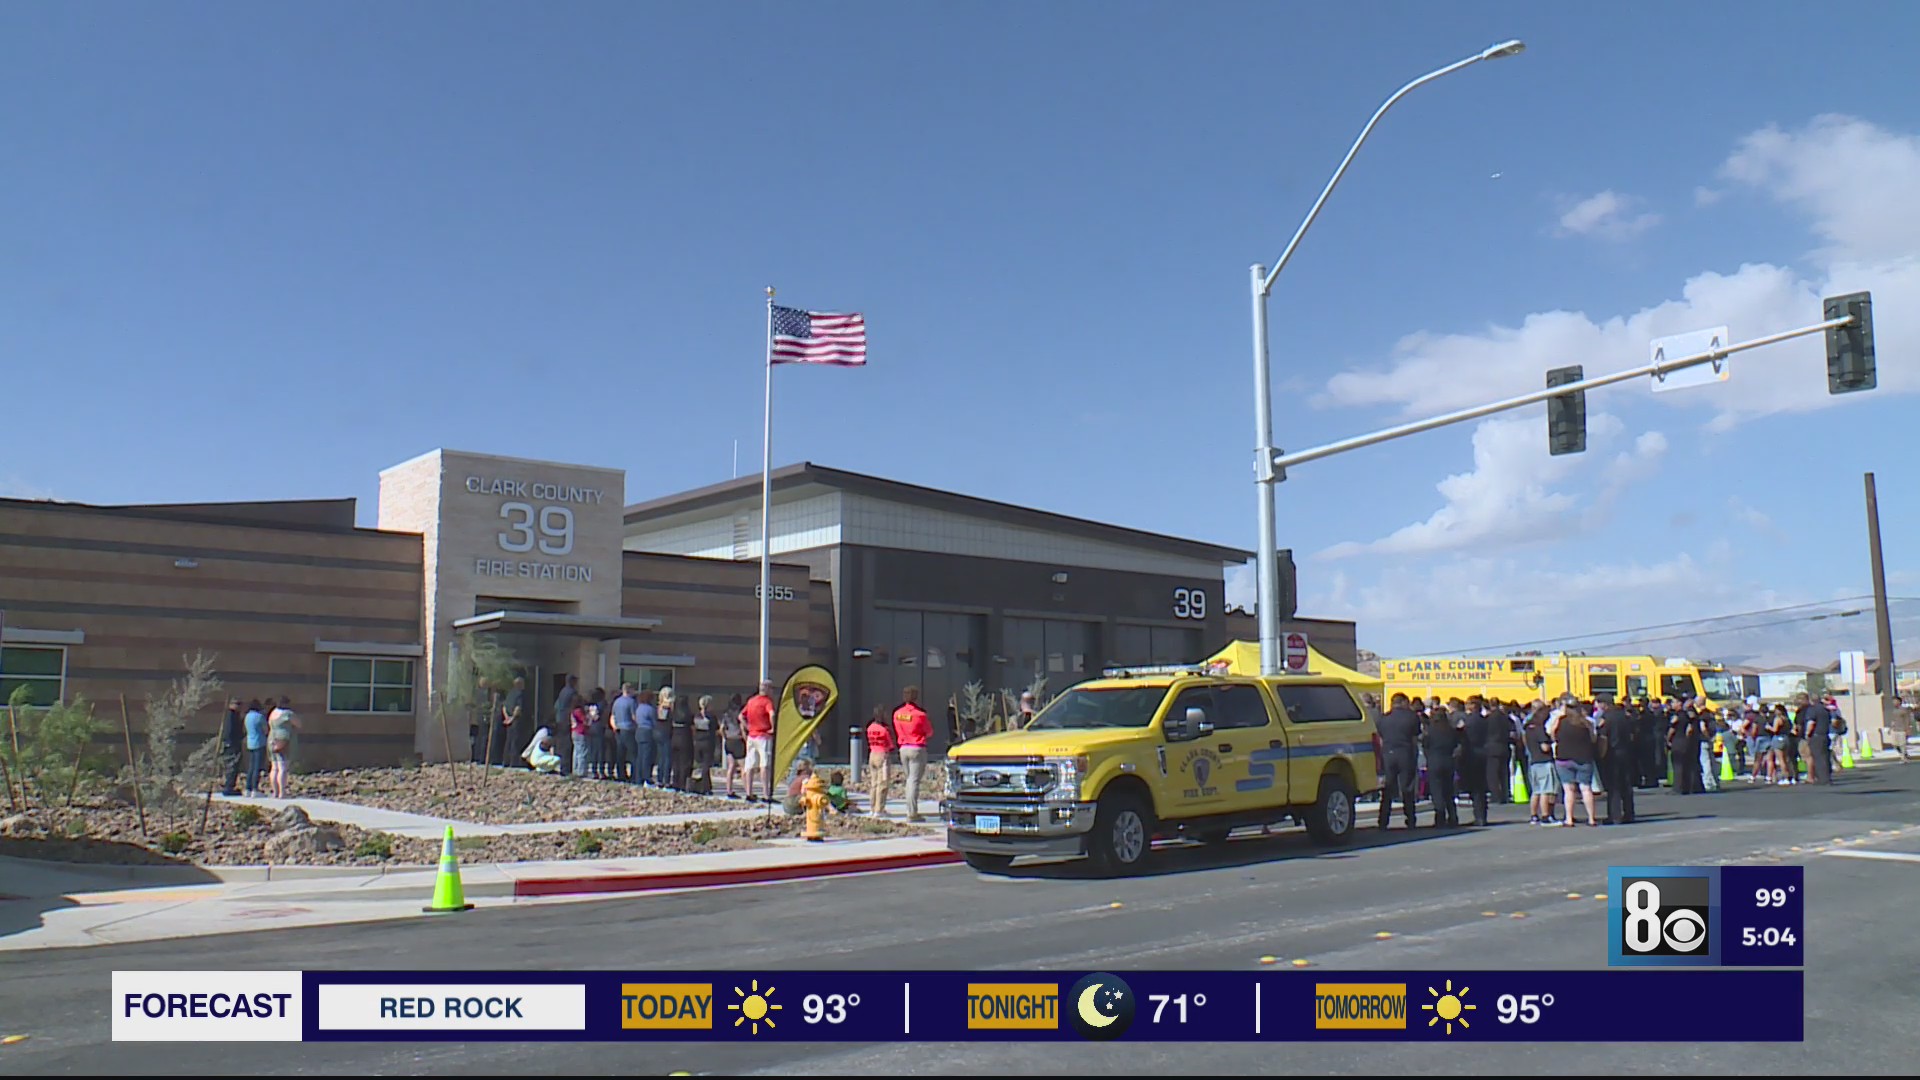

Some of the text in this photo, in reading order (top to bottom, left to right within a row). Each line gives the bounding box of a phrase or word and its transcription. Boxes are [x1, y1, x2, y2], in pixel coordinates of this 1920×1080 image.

[465, 476, 605, 504] CLARK COUNTY
[498, 501, 575, 556] 39
[475, 559, 593, 583] FIRE STATION
[1173, 588, 1206, 619] 39
[1398, 660, 1505, 673] CLARK COUNTY
[1412, 671, 1492, 680] FIRE DEPARTMENT
